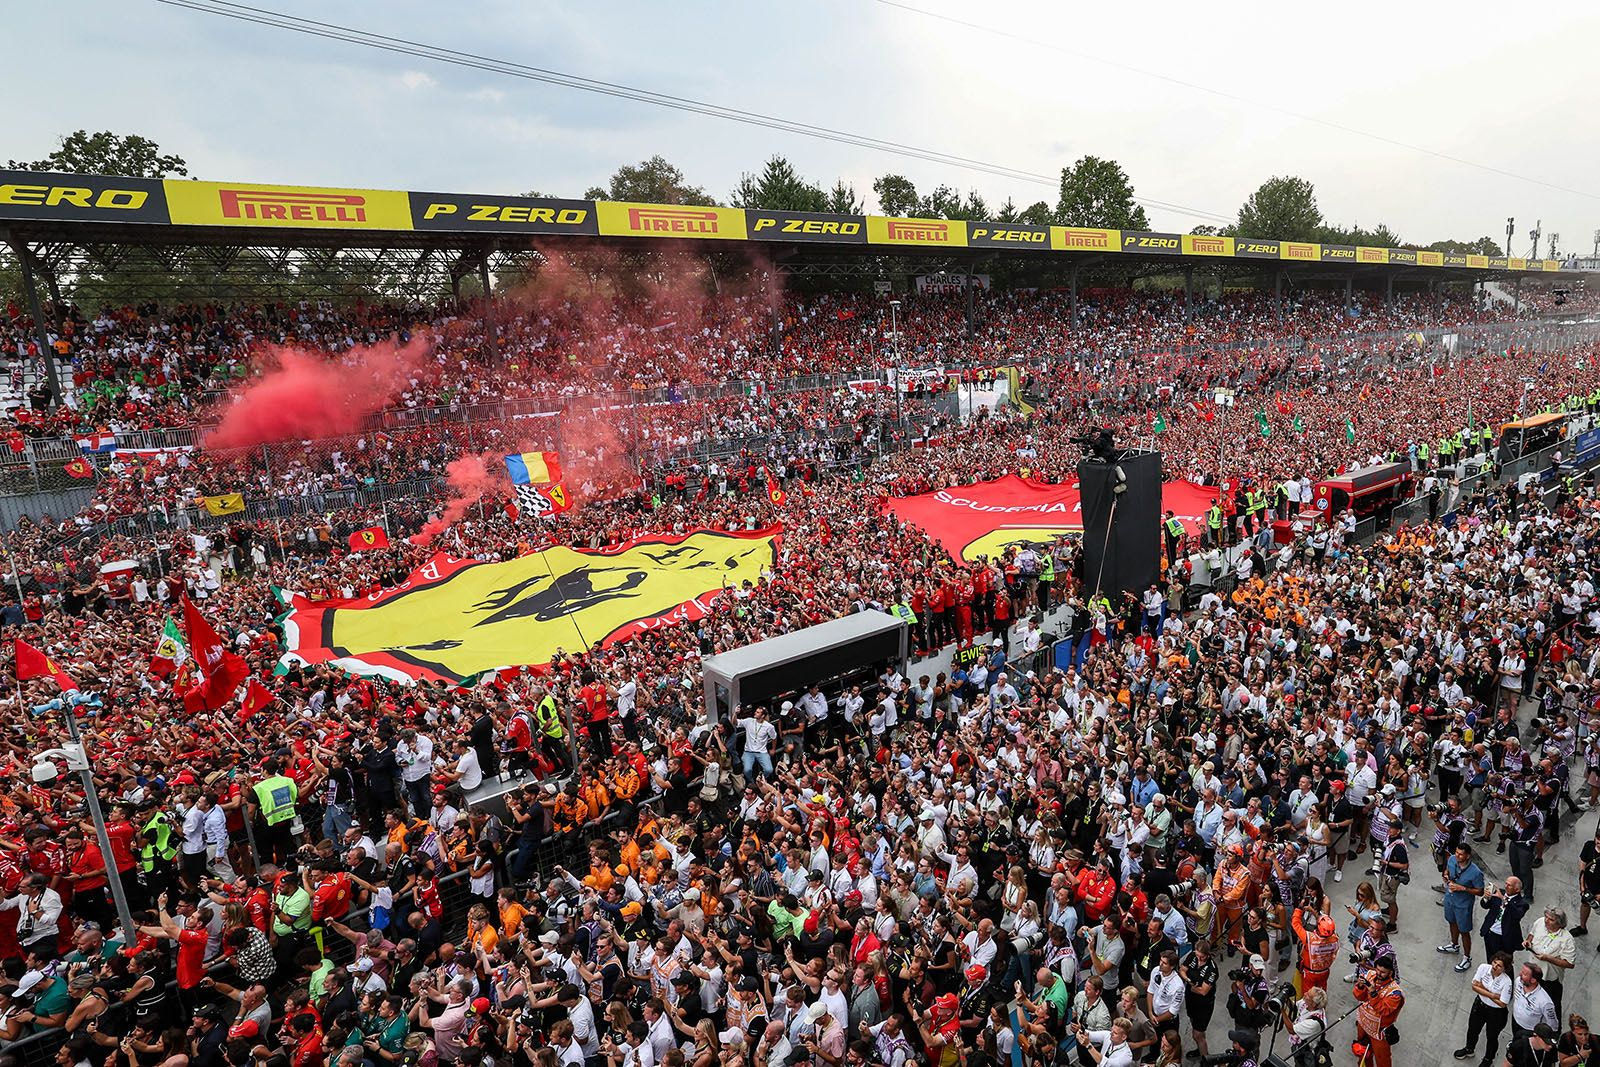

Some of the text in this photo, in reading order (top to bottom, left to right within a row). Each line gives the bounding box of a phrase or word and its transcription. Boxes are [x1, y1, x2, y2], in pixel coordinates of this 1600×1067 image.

[219, 189, 366, 223] PIRELLI
[423, 203, 587, 224] P ZERO
[629, 208, 718, 233] PIRELLI
[754, 218, 861, 236] P ZERO
[887, 221, 948, 242] PIRELLI
[972, 228, 1046, 243] P ZERO
[1065, 231, 1107, 247] PIRELLI
[1124, 236, 1179, 249] P ZERO
[1192, 238, 1225, 253] PIRELLI
[1237, 243, 1278, 254] P ZERO
[1288, 245, 1313, 258] PIRELLI
[1322, 249, 1355, 258] P ZERO
[1396, 253, 1416, 262] ZERO
[925, 275, 961, 285] CHARLES
